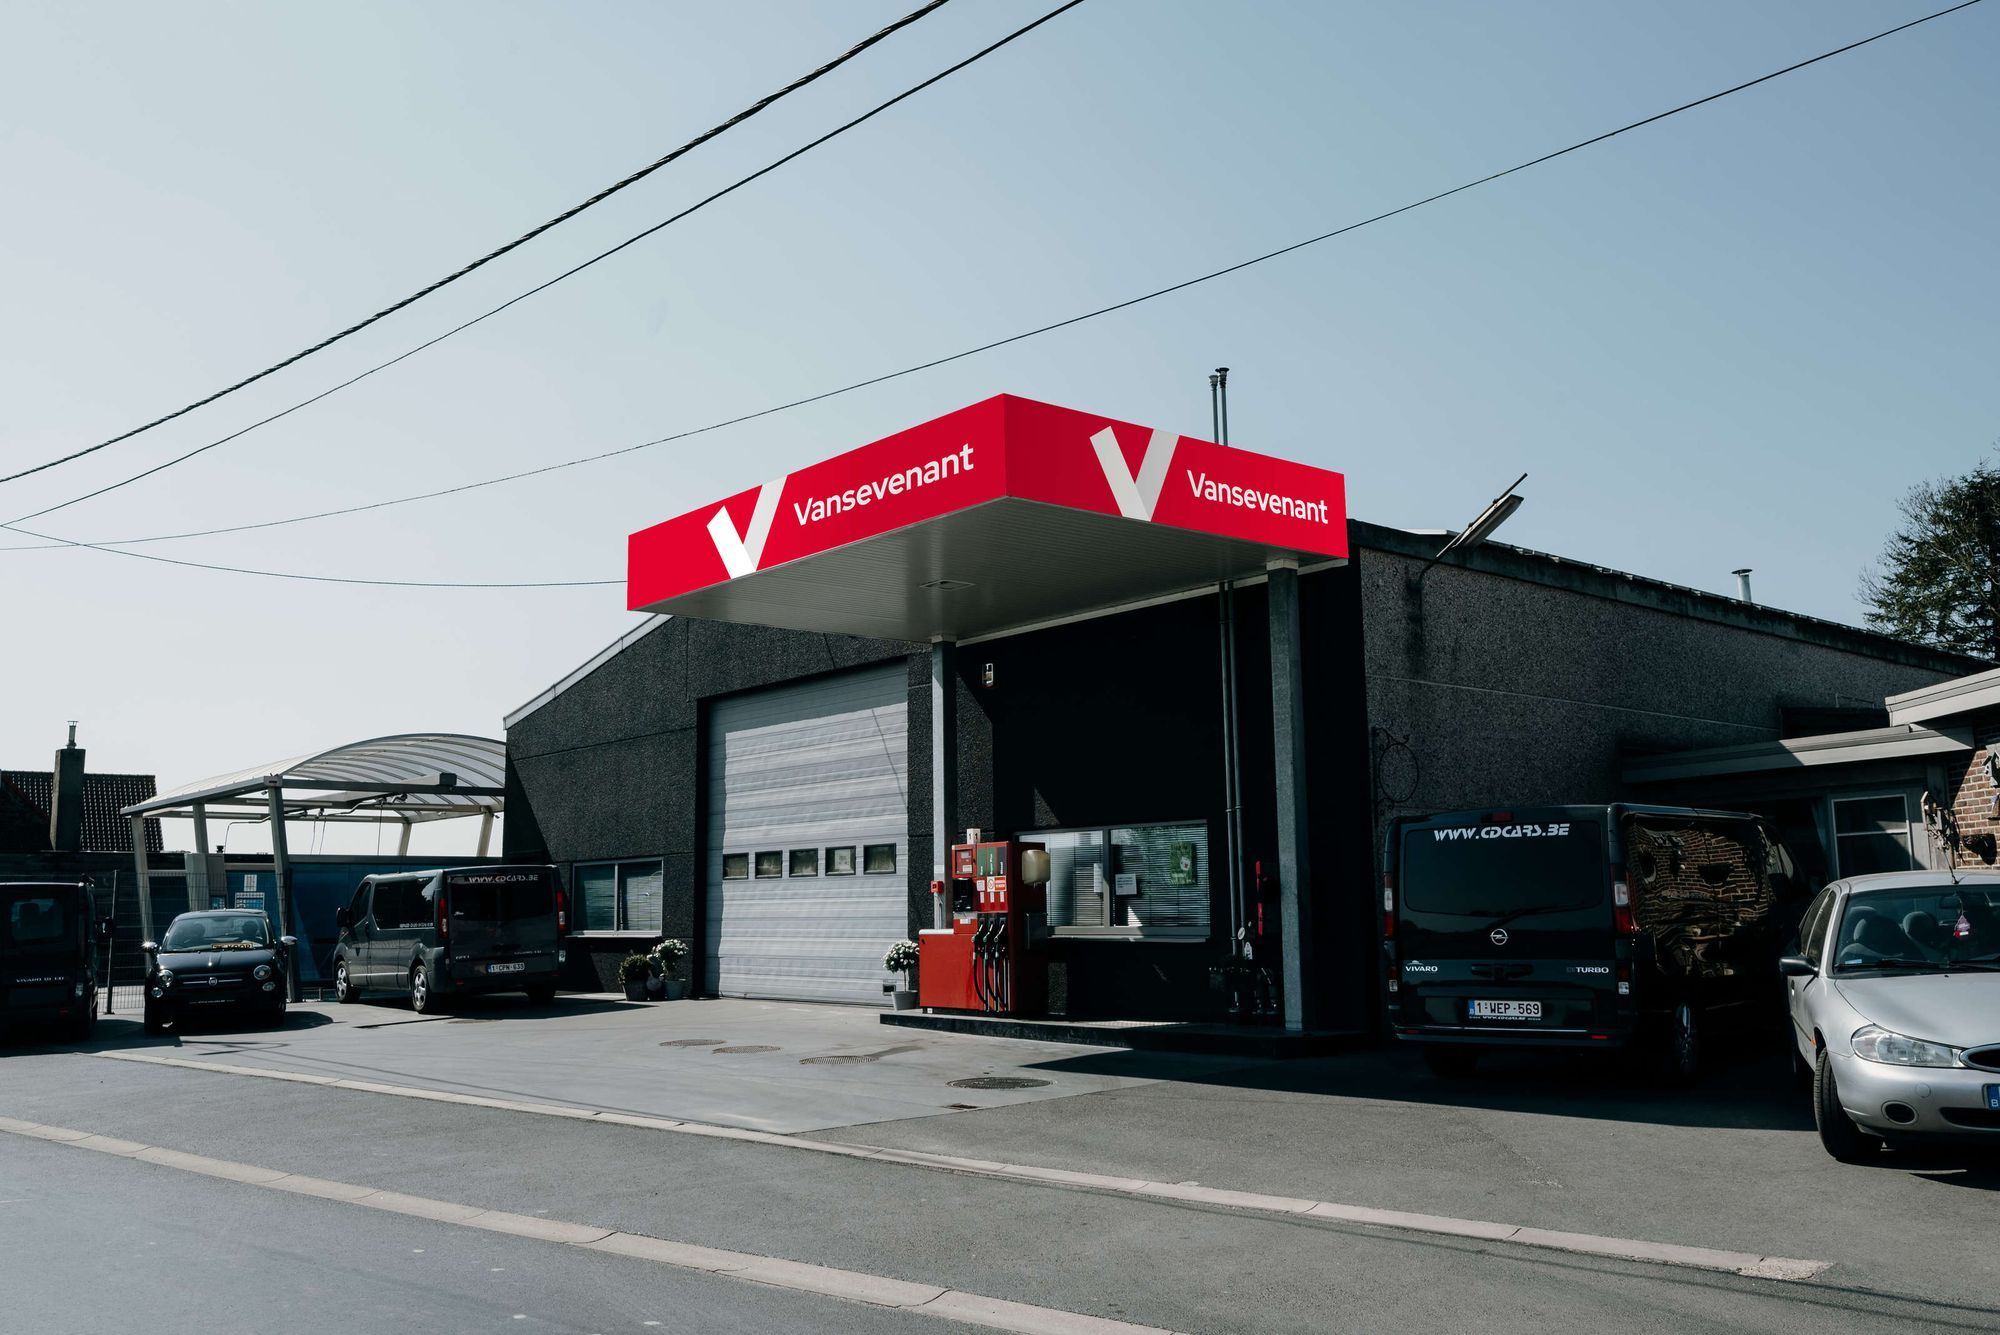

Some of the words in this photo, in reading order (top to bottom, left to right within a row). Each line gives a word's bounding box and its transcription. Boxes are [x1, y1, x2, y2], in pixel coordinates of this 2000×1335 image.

[793, 443, 974, 526] Vansevenant
[1186, 469, 1329, 525] Vansevenant
[1434, 824, 1570, 841] WWW.CDCARS.BE
